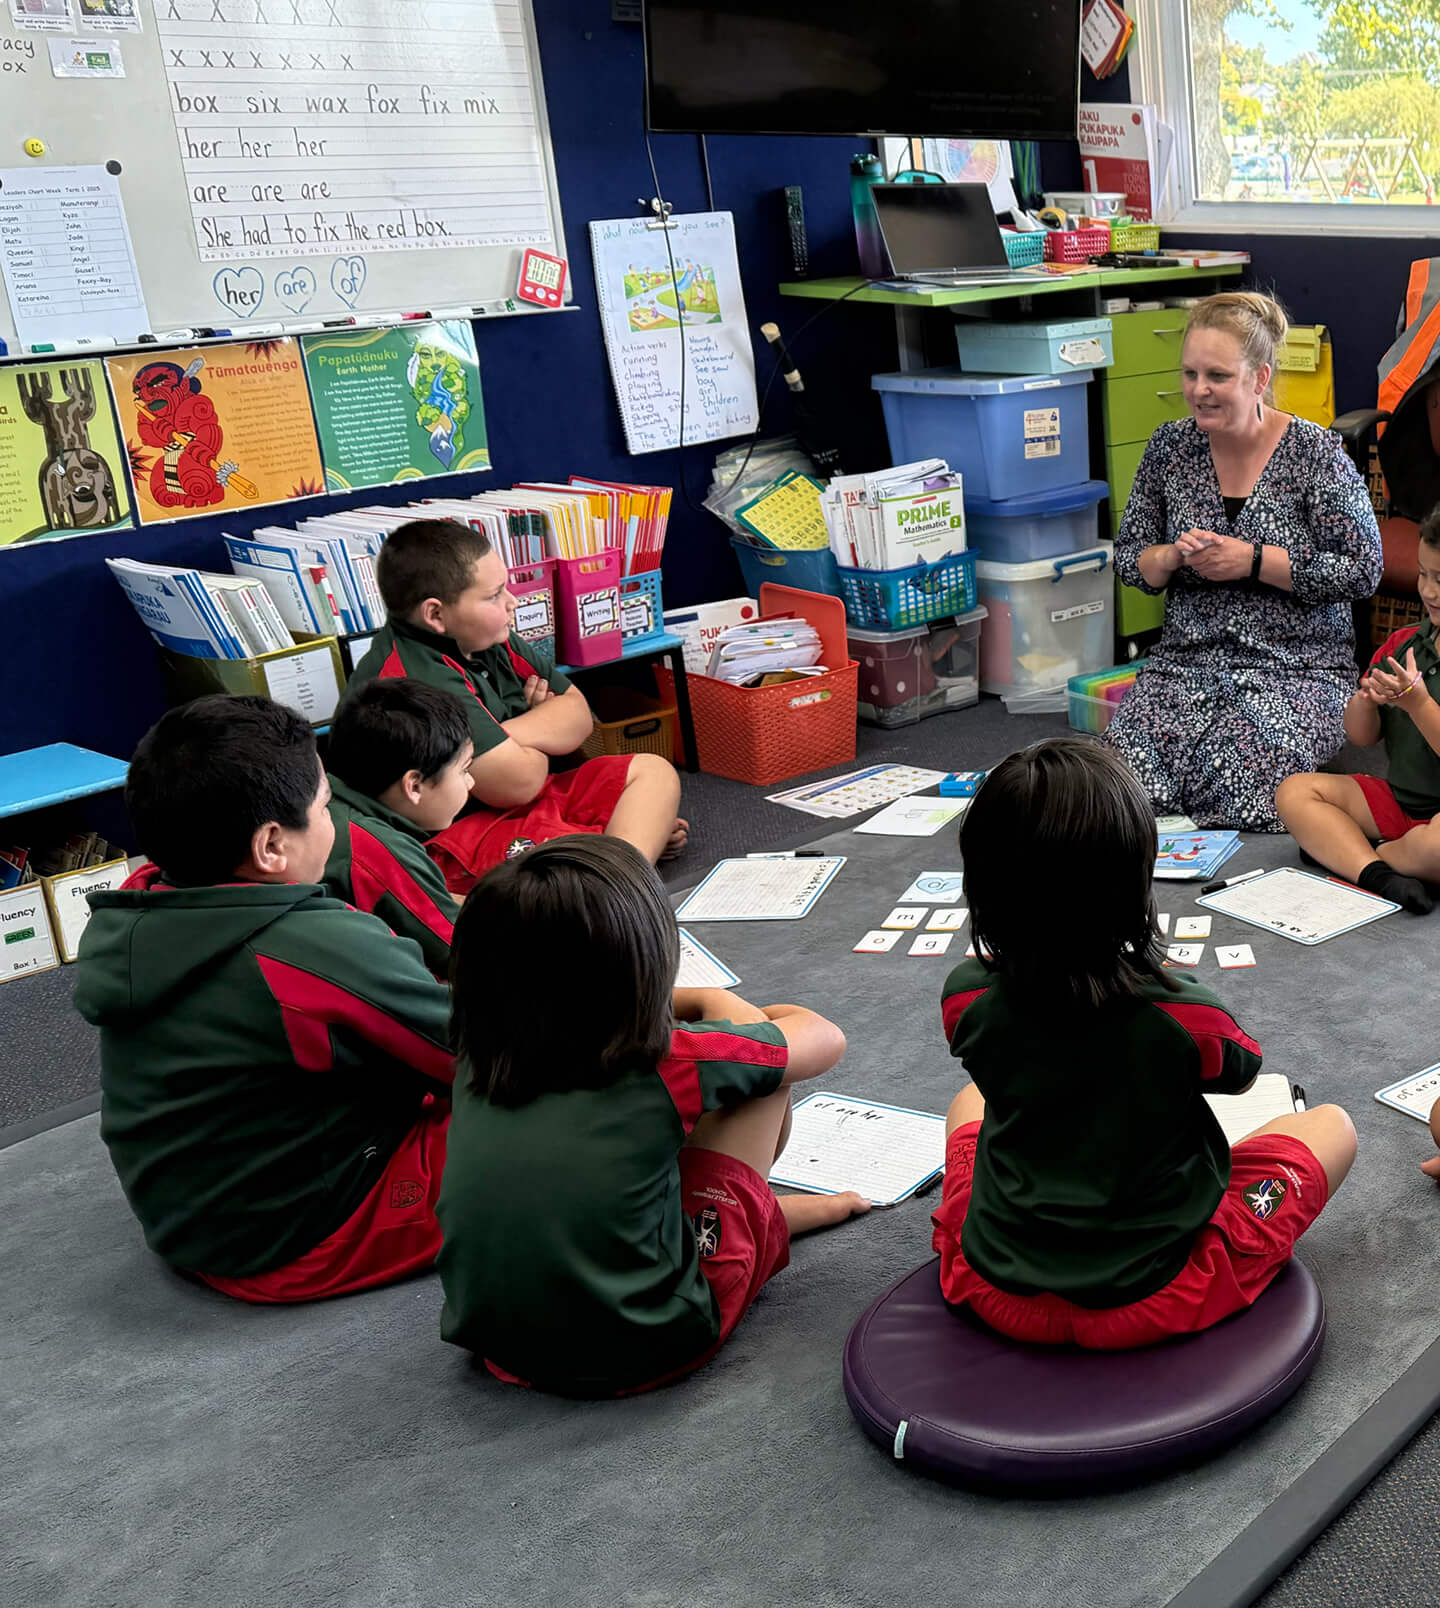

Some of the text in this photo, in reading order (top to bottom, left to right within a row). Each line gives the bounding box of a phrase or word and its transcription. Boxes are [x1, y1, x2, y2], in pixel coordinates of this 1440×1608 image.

[174, 81, 500, 114] box six wax fox fix mix
[1080, 123, 1125, 136] PUKAPUKA
[185, 127, 327, 158] her her her
[1080, 134, 1120, 147] KAUPAPA
[1132, 163, 1147, 172] MY
[1084, 160, 1098, 194] 1
[194, 182, 331, 202] are are are
[201, 208, 452, 248] She had to fix the red box.
[340, 262, 360, 294] of
[224, 277, 259, 306] her
[283, 280, 307, 296] are
[624, 354, 657, 366] running
[336, 364, 387, 375] Earth Mother
[625, 368, 660, 380] climbing
[696, 376, 717, 392] boy
[896, 501, 951, 526] PRIME
[904, 520, 947, 536] Mathematics
[520, 611, 543, 622] Inquiry
[586, 607, 611, 618] Writing
[71, 880, 112, 896] Fluency
[925, 941, 937, 950] g
[1178, 948, 1189, 957] b
